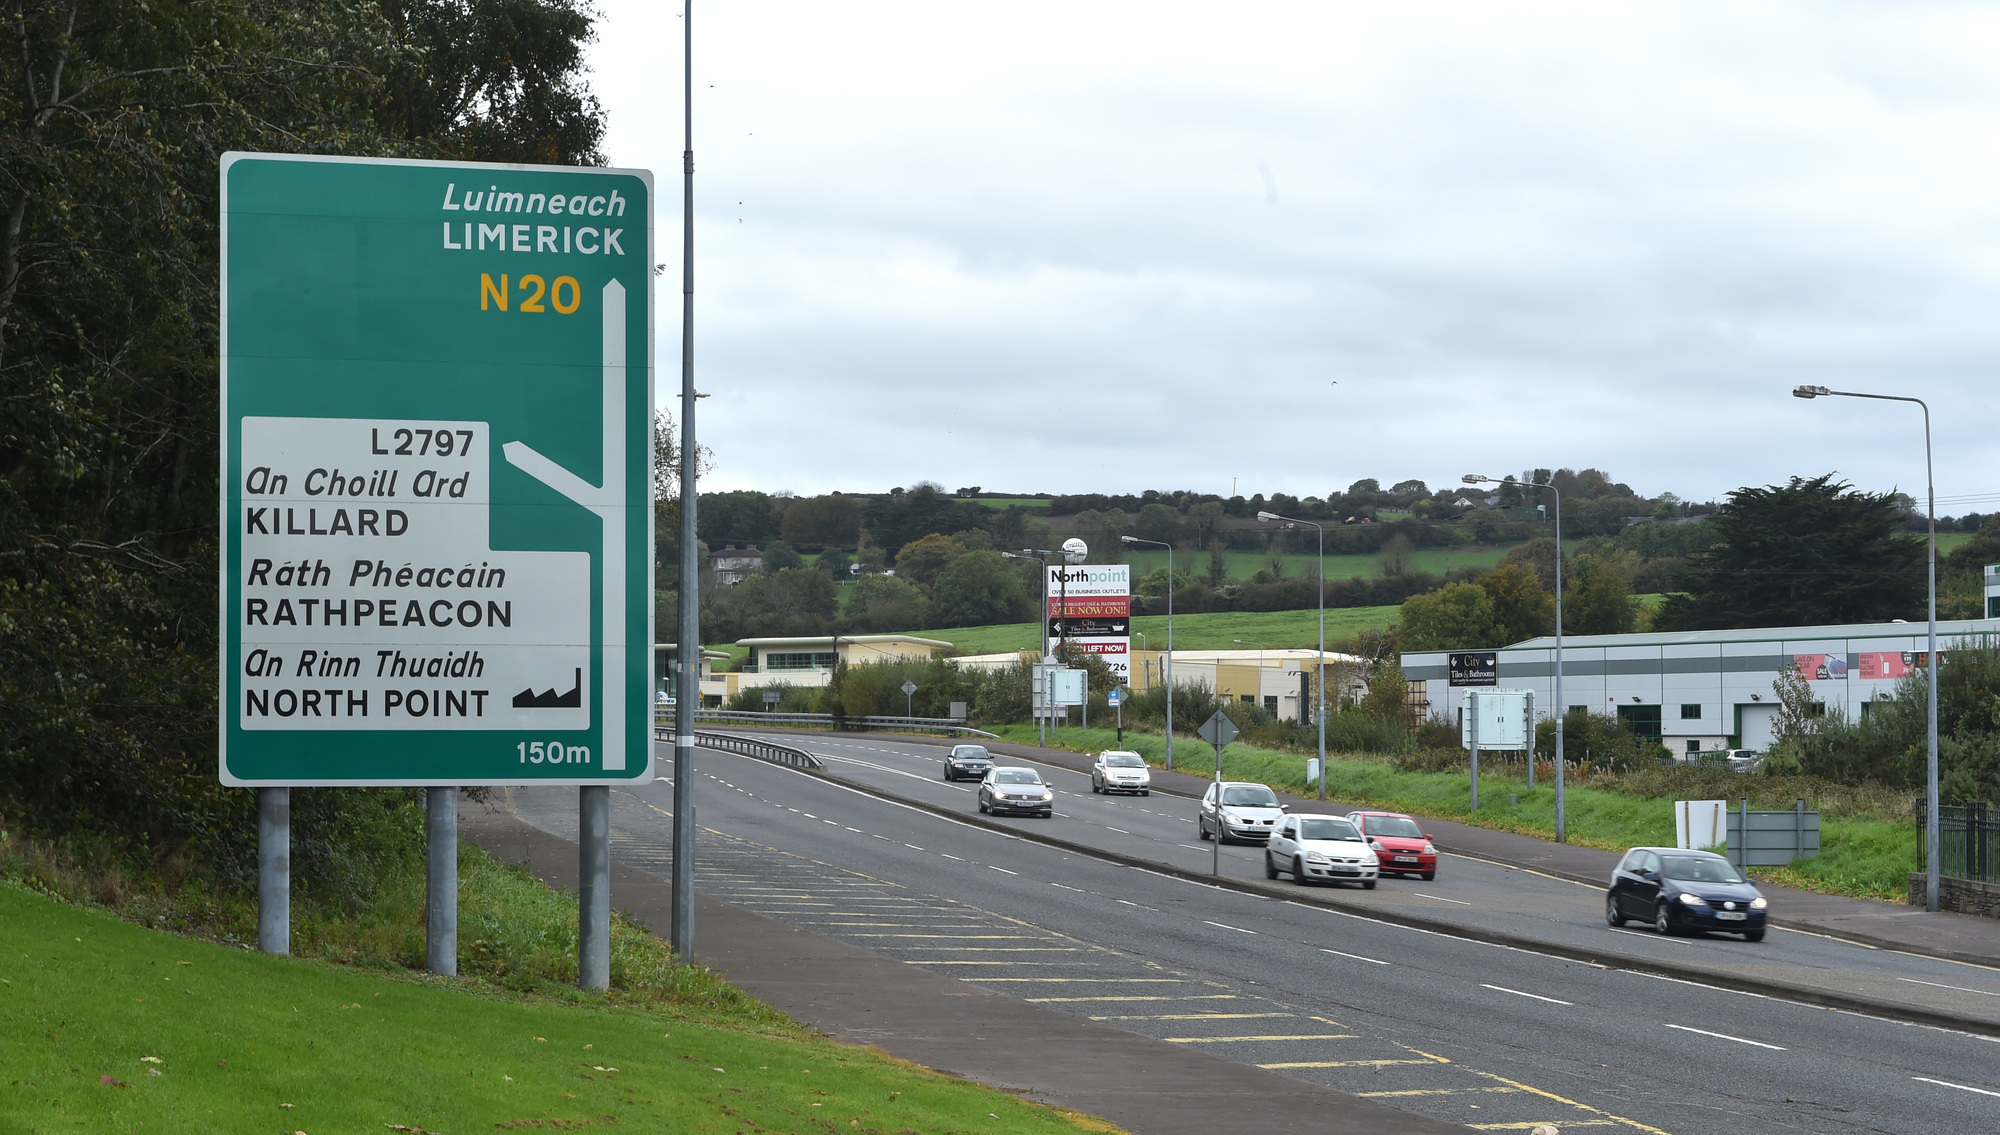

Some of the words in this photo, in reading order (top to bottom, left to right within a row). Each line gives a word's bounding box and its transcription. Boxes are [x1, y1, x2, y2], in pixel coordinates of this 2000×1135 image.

[442, 183, 626, 217] Luimneach
[443, 222, 626, 256] LIMERICK
[371, 428, 474, 457] L2797
[246, 466, 288, 496] An
[304, 468, 399, 498] Choill
[412, 470, 470, 498] Ard
[246, 507, 410, 537] KILLARD
[247, 558, 332, 587] Ráth
[349, 559, 506, 589] Phéacáin
[1051, 568, 1127, 585] Northpoint
[246, 598, 512, 627] RATHPEACON
[1078, 606, 1103, 615] NOW
[1105, 606, 1126, 615] ON!!
[245, 649, 283, 678] An
[296, 649, 362, 678] Rinn
[375, 650, 485, 678] Thuaidh
[1450, 670, 1463, 678] Tiles
[1469, 669, 1495, 678] Bathrooms
[1463, 655, 1480, 669] City
[246, 689, 369, 717] NORTH
[384, 689, 490, 718] POINT
[517, 741, 591, 764] 150m
